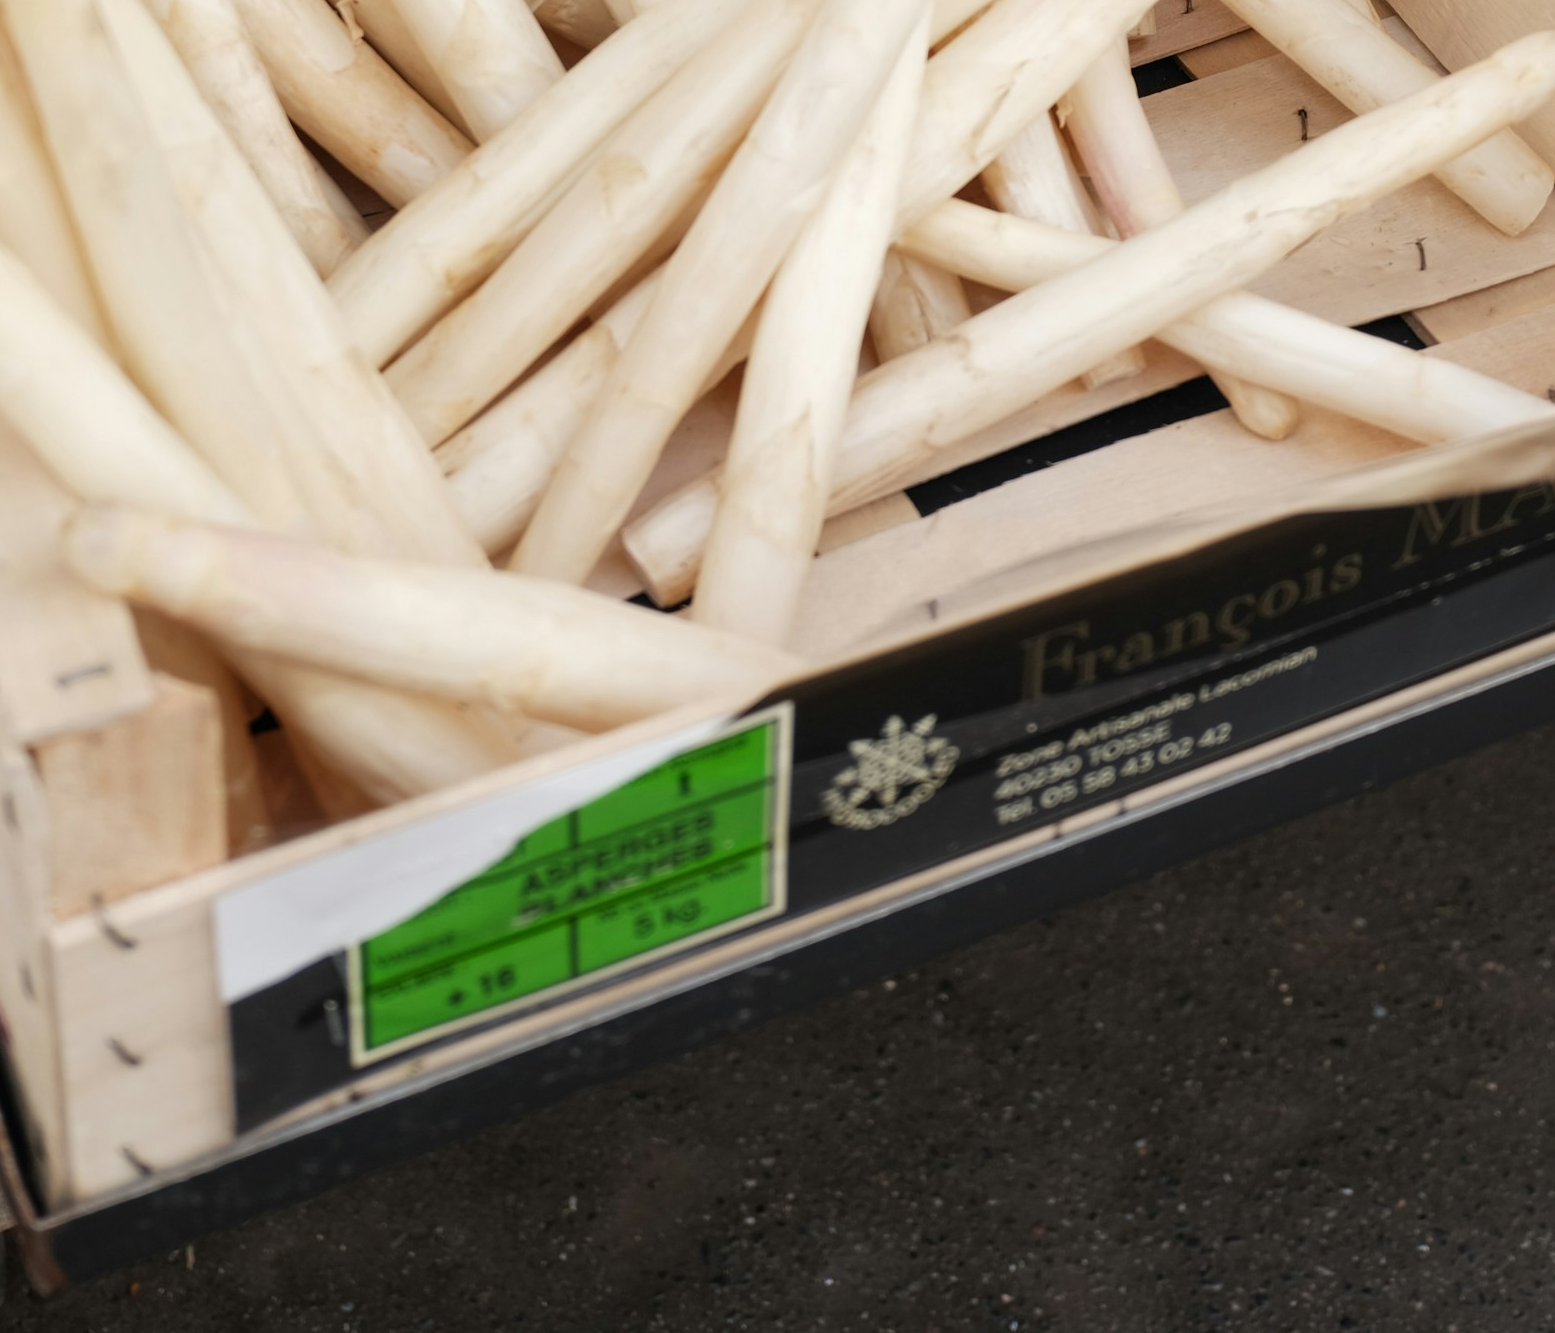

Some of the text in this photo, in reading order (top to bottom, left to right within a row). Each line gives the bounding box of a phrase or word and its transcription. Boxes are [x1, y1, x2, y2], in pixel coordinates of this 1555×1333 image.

[1020, 542, 1364, 707] François
[992, 755, 1083, 803] 40230
[1087, 719, 1175, 780] TOSSE
[995, 741, 1064, 780] Zone
[1066, 690, 1197, 752] Artisanale
[1038, 779, 1080, 812] 05
[1081, 765, 1118, 799] 58
[1119, 753, 1155, 788] 43
[1157, 740, 1197, 773] 02
[1196, 722, 1234, 761] 42
[521, 808, 718, 897] ASPERGES
